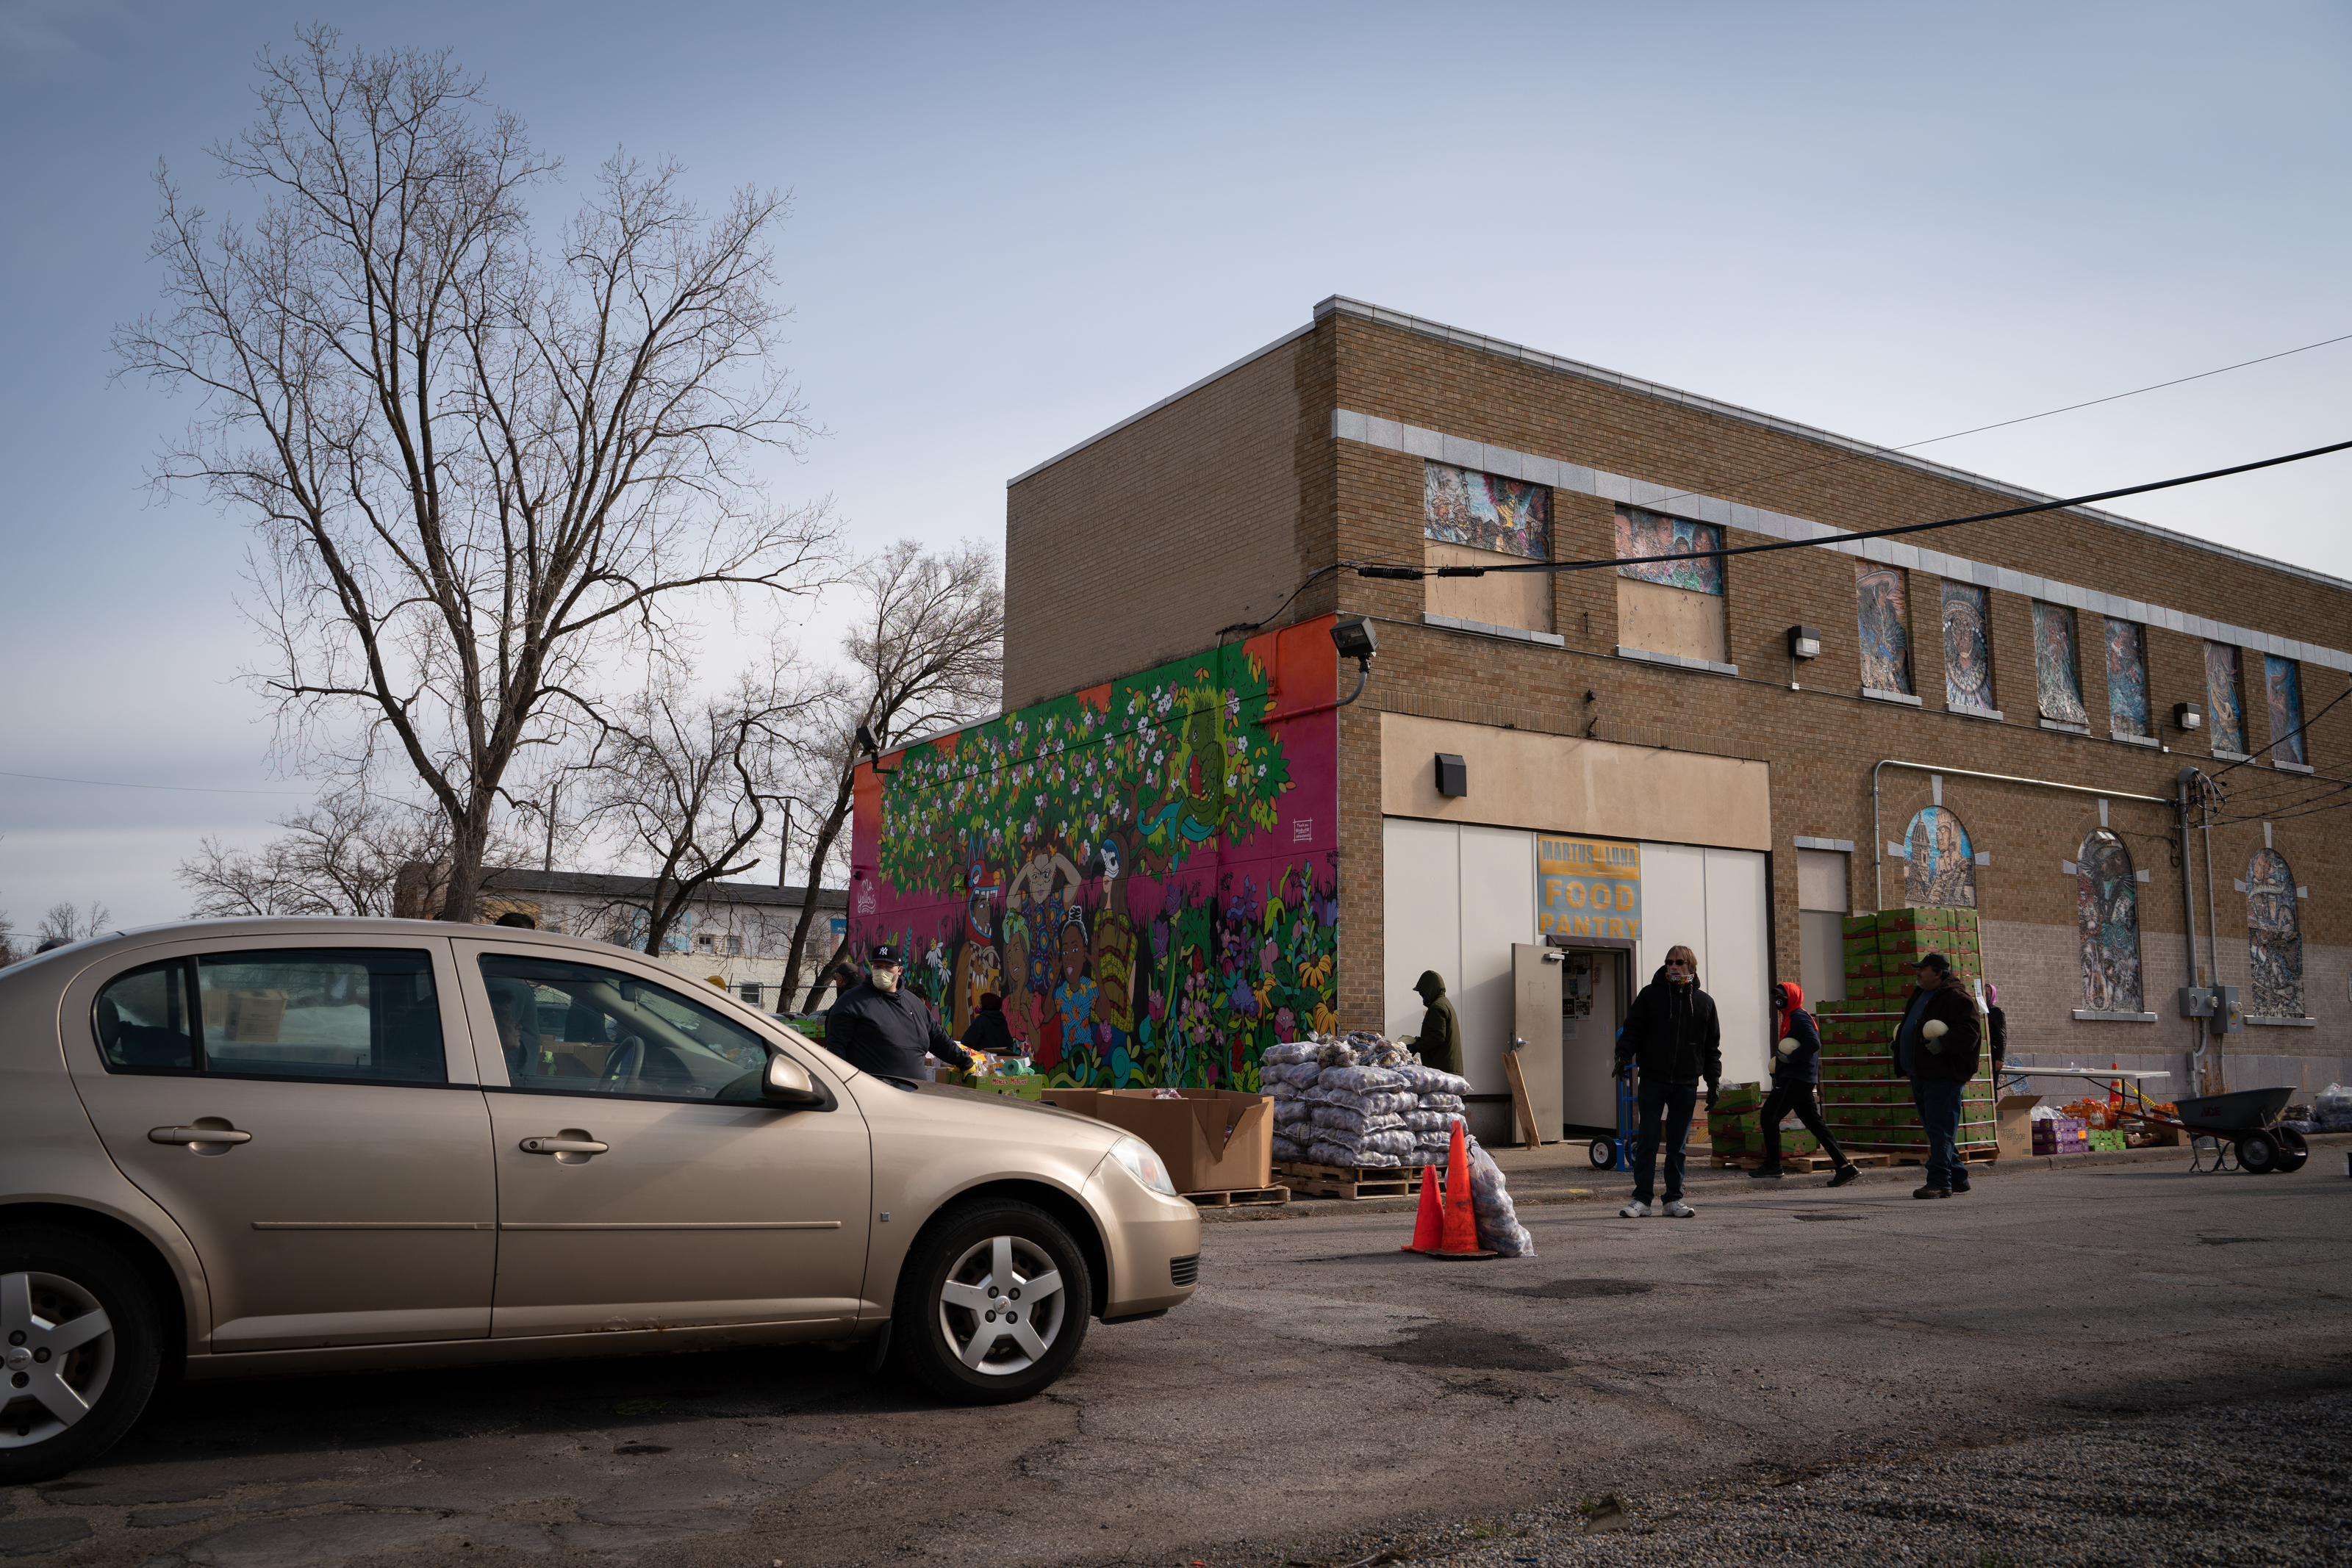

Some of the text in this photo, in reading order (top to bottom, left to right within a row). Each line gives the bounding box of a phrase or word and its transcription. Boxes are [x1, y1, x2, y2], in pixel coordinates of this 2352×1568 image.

[1542, 841, 1594, 864] MARTUS
[1606, 846, 1636, 867] LUNA
[1546, 879, 1634, 911] FOOD
[1539, 913, 1640, 938] PANTRY
[2200, 1106, 2222, 1117] ACE
[2000, 1128, 2016, 1137] green
